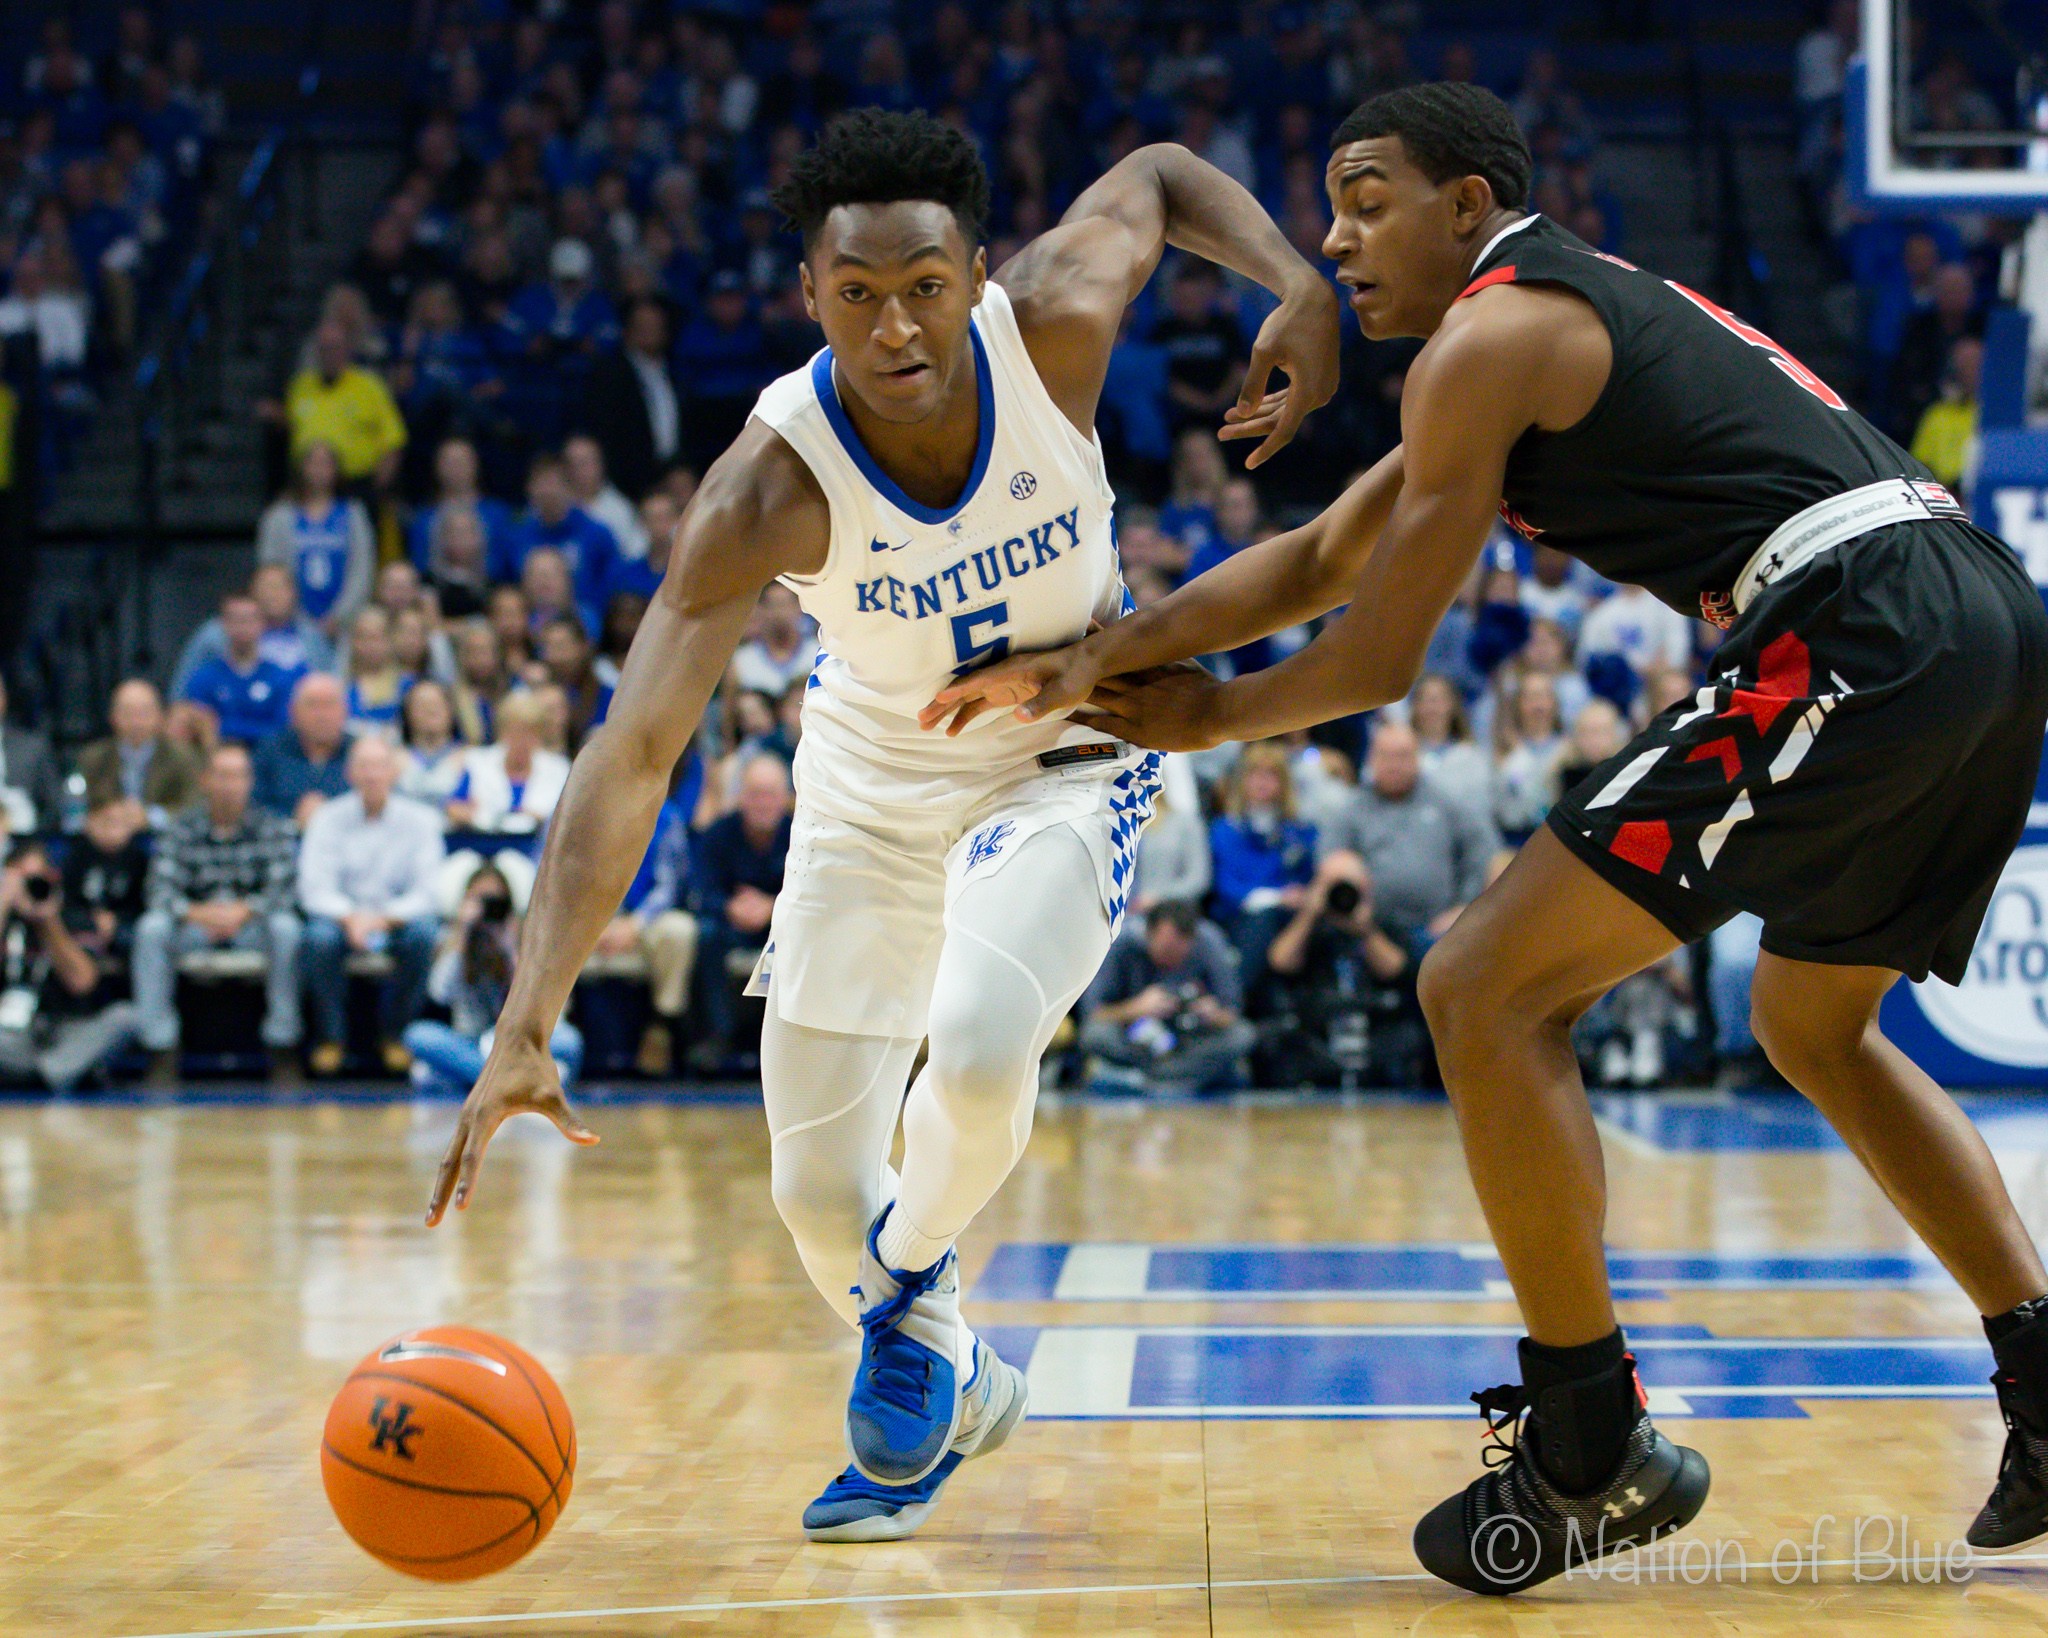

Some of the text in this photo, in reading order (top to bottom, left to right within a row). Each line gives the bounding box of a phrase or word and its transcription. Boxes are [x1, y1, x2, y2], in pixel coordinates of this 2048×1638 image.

[1010, 471, 1038, 500] SEC
[855, 504, 1081, 620] KENTUCKY
[950, 600, 1011, 678] 5
